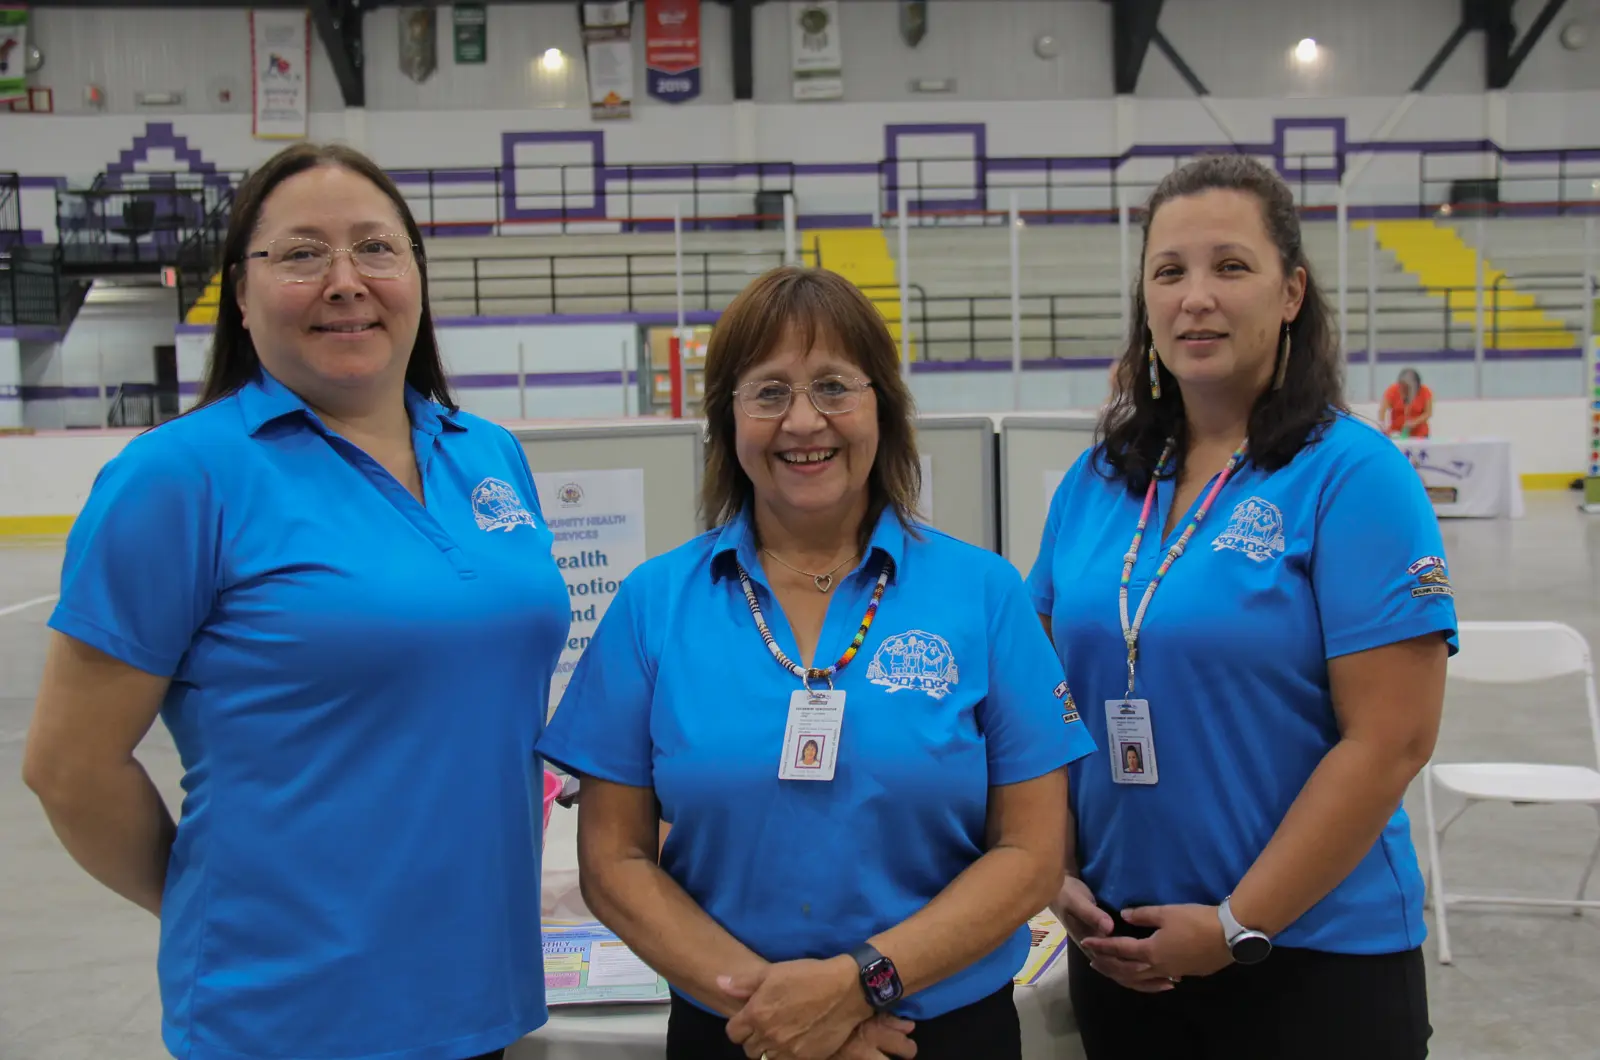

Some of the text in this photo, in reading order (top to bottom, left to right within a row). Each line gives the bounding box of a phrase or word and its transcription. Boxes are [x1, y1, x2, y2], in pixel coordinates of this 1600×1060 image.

[656, 79, 691, 93] 2019
[586, 514, 626, 526] HEALTH
[552, 549, 608, 569] ealth
